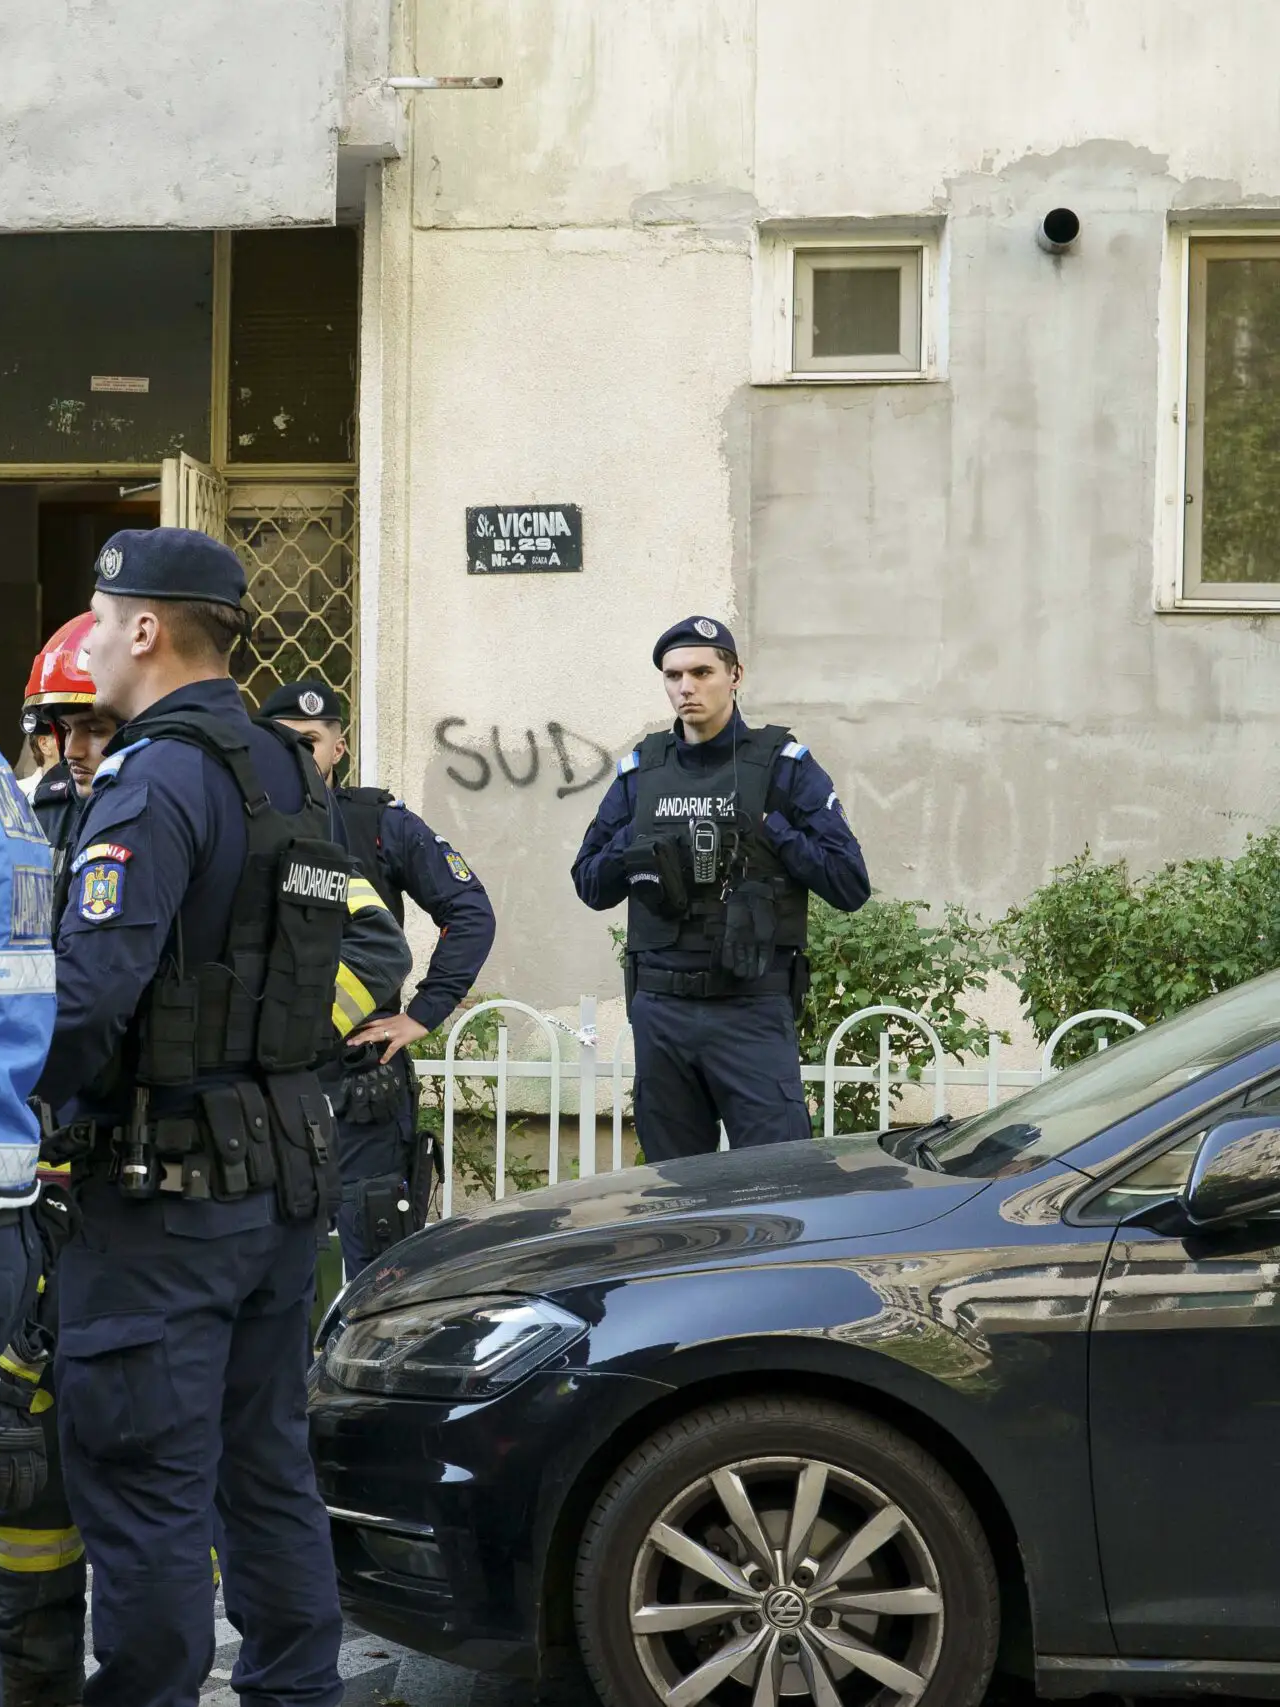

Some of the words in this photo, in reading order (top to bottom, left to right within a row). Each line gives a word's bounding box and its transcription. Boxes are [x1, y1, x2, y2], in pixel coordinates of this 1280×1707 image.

[476, 513, 496, 538] Str.
[498, 511, 571, 537] VICINA
[549, 552, 561, 566] A
[434, 717, 612, 799] SUD
